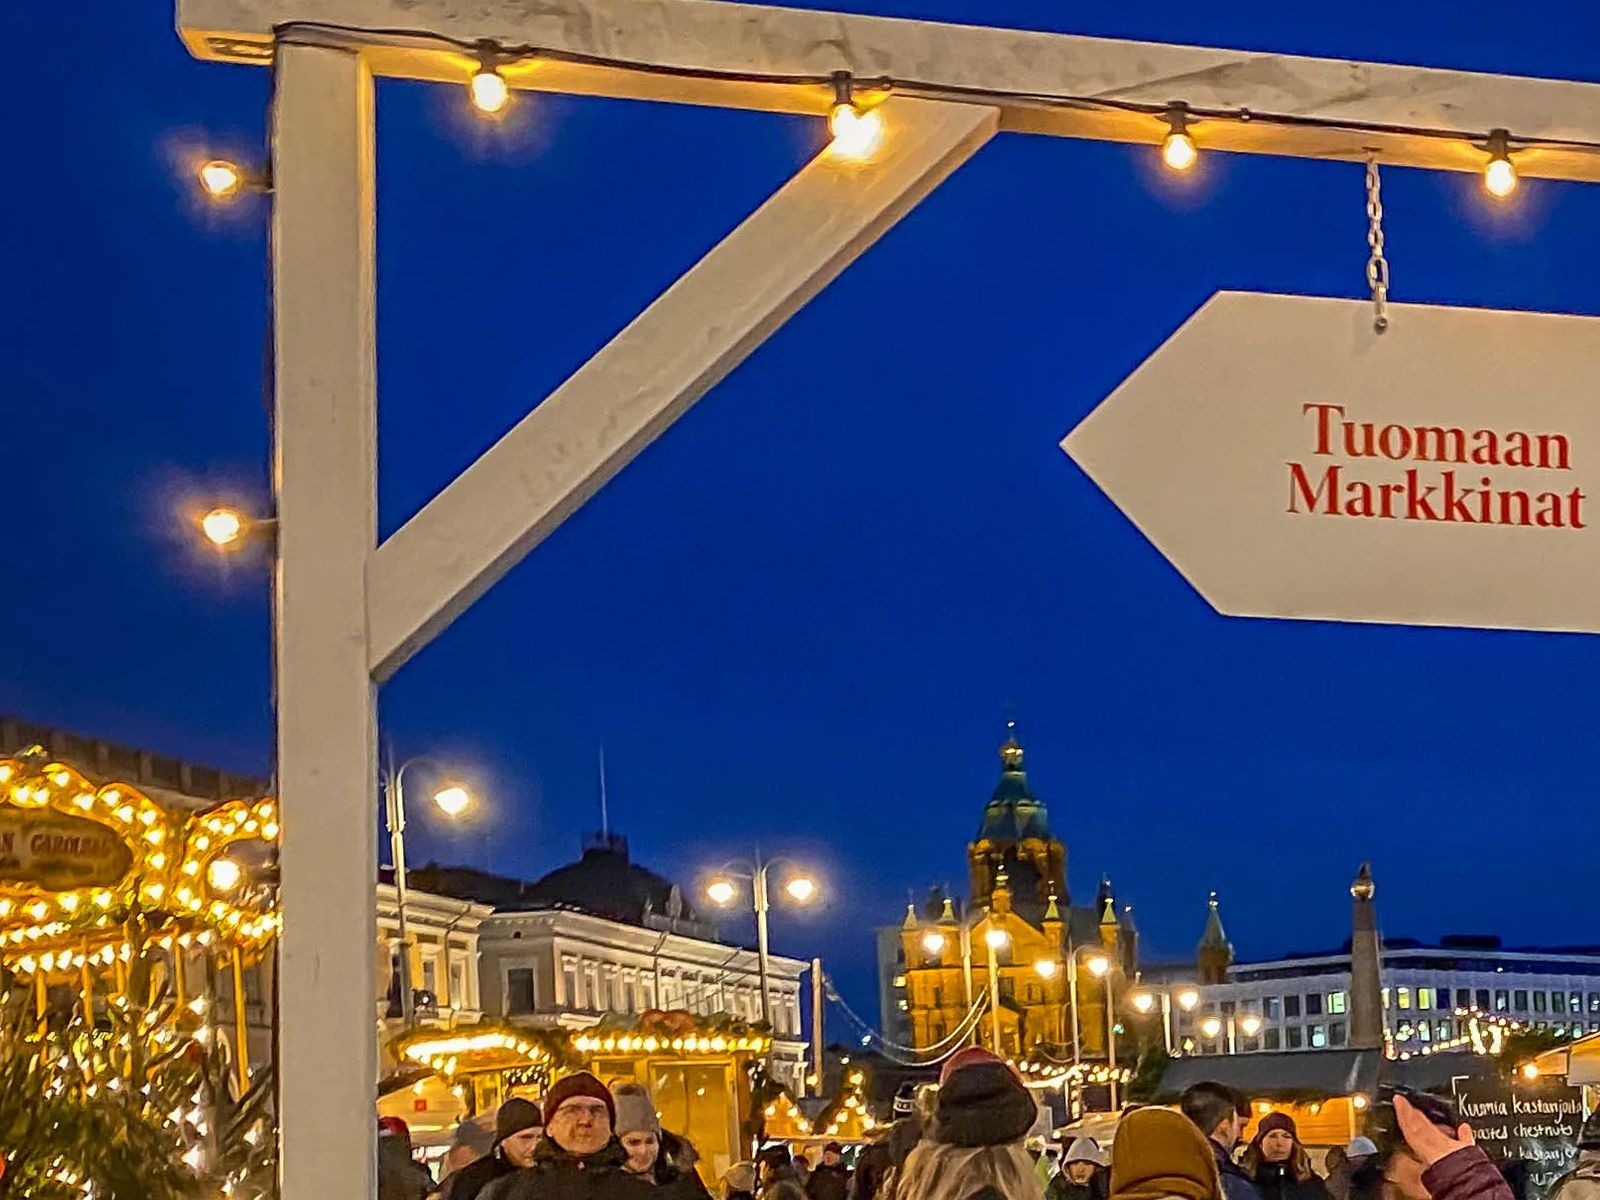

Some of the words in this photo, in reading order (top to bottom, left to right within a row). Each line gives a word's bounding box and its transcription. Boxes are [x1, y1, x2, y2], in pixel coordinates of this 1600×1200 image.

[1302, 403, 1569, 470] Tuomaan
[1288, 461, 1584, 529] Markkinat
[1472, 1125, 1509, 1140] oasted
